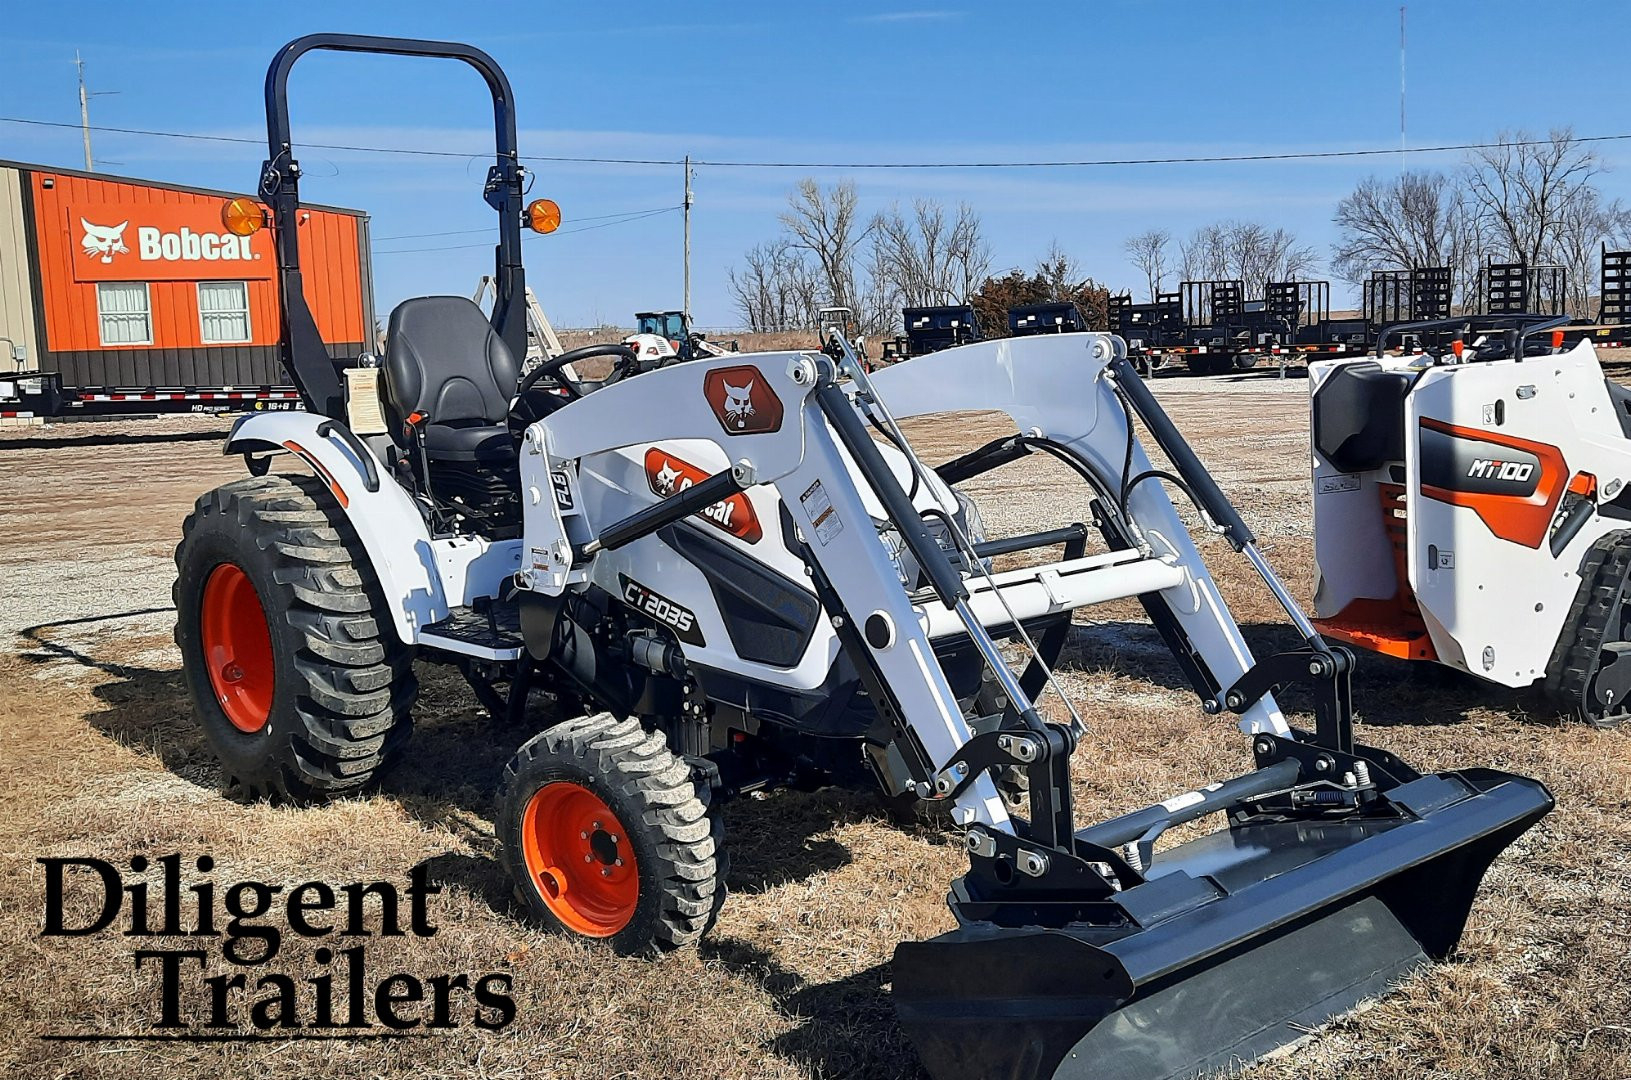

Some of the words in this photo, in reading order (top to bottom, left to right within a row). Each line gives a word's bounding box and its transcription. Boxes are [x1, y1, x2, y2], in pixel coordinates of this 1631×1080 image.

[138, 226, 253, 261] Bobcat
[191, 404, 203, 412] HD
[1467, 459, 1534, 481] MT100
[625, 583, 694, 632] CT2035
